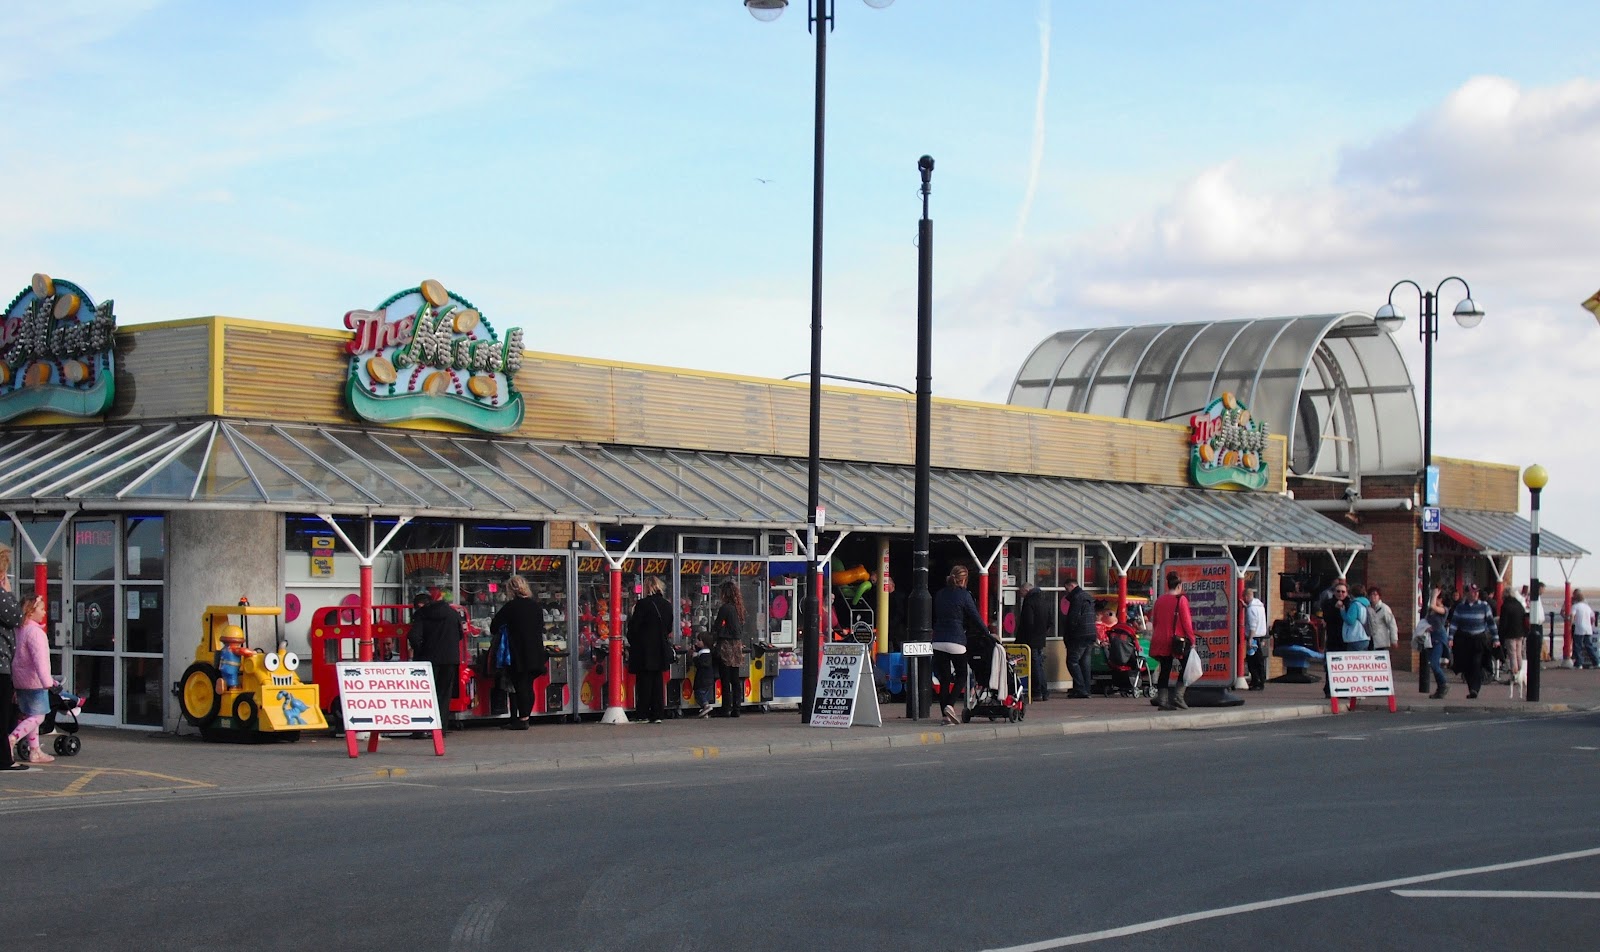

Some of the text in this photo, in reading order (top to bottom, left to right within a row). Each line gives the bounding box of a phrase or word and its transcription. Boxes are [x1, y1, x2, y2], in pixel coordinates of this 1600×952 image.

[344, 309, 417, 355] The
[1190, 414, 1222, 445] The
[1202, 566, 1227, 576] MARCH
[904, 644, 933, 653] CENTRA
[825, 656, 857, 665] ROAD
[344, 680, 430, 690] NO PARKING
[821, 680, 854, 689] TRAIN
[823, 689, 849, 697] STOP
[347, 699, 433, 710] ROAD TRAIN
[374, 715, 410, 725] PASS
